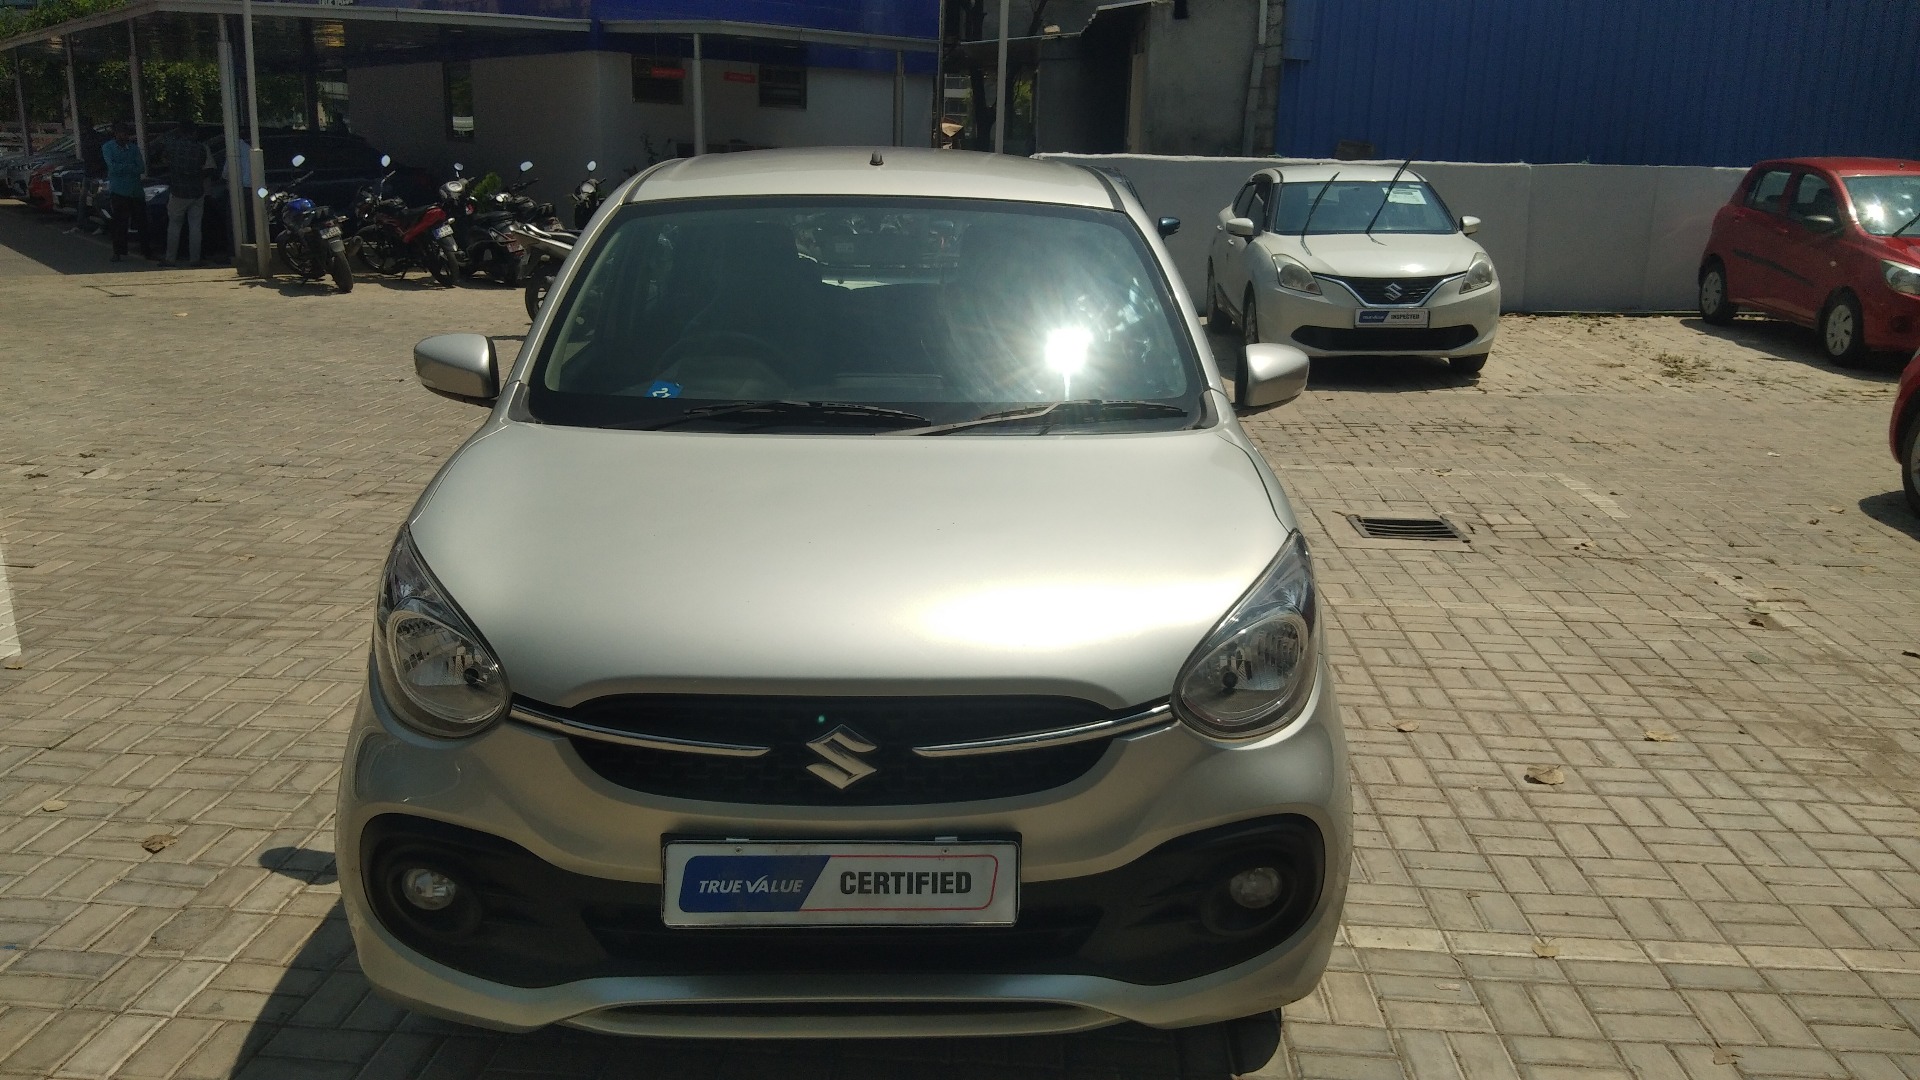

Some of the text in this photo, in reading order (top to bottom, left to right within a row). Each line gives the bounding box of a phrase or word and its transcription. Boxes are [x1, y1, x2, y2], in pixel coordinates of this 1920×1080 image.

[698, 871, 972, 895] TRUE VALUE CERTIFIED
